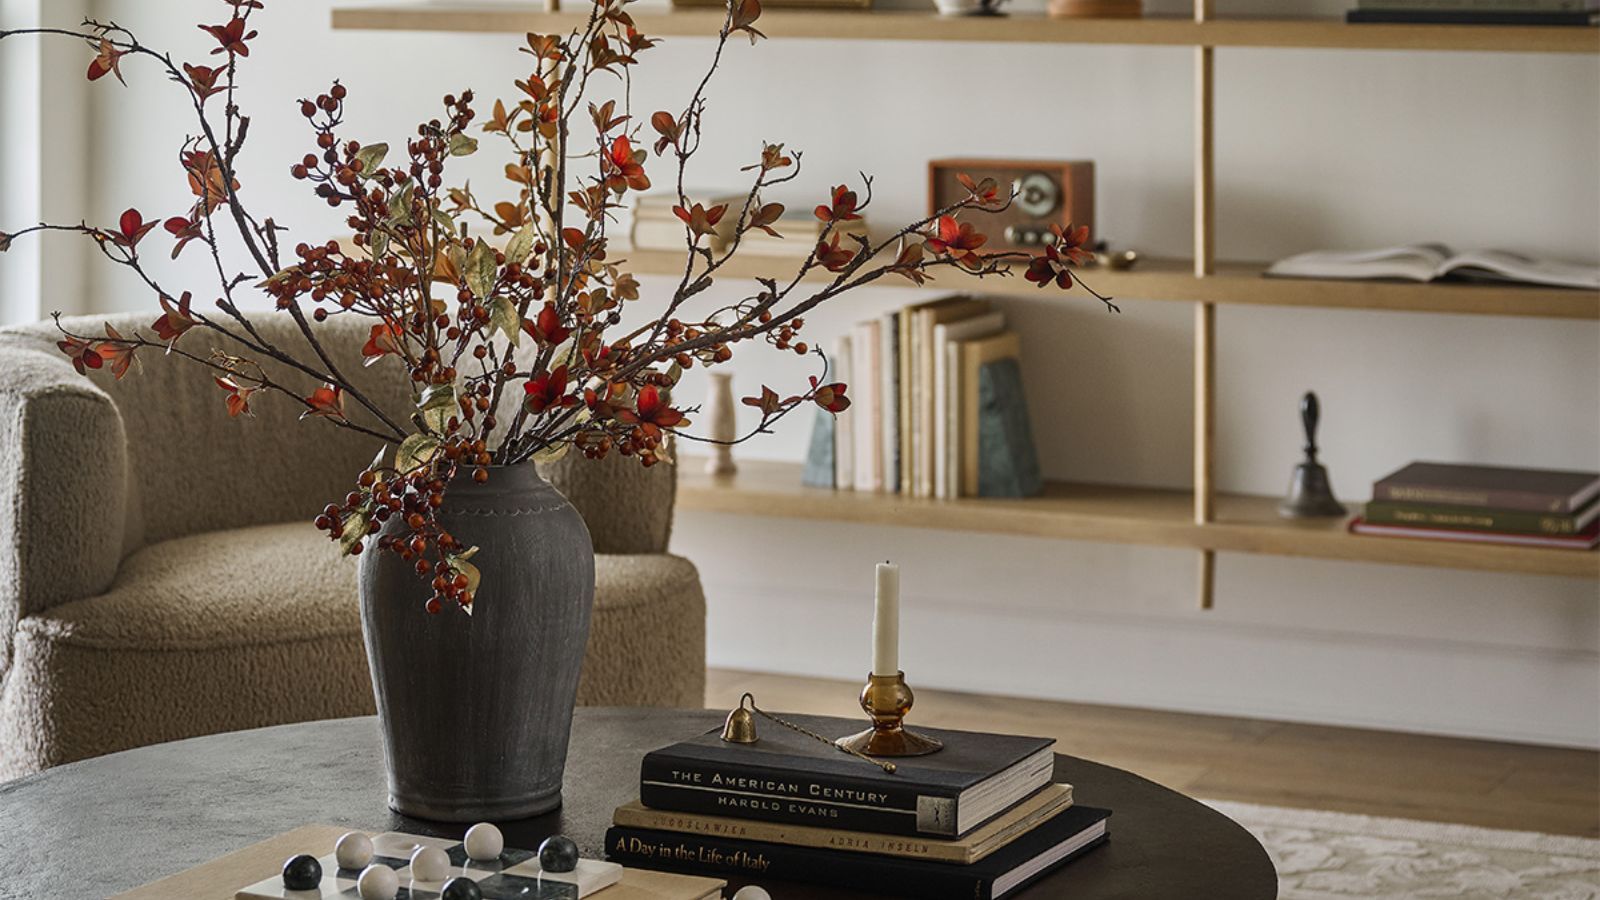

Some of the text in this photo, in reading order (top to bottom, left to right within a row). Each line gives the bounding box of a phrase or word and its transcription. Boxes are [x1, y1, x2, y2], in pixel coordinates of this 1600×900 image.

[672, 770, 889, 804] THE AMERICAN CENTURY
[718, 796, 839, 818] HAROLD EVANS
[615, 836, 771, 872] A Day in the Life of Italy
[829, 837, 869, 849] ADRIA
